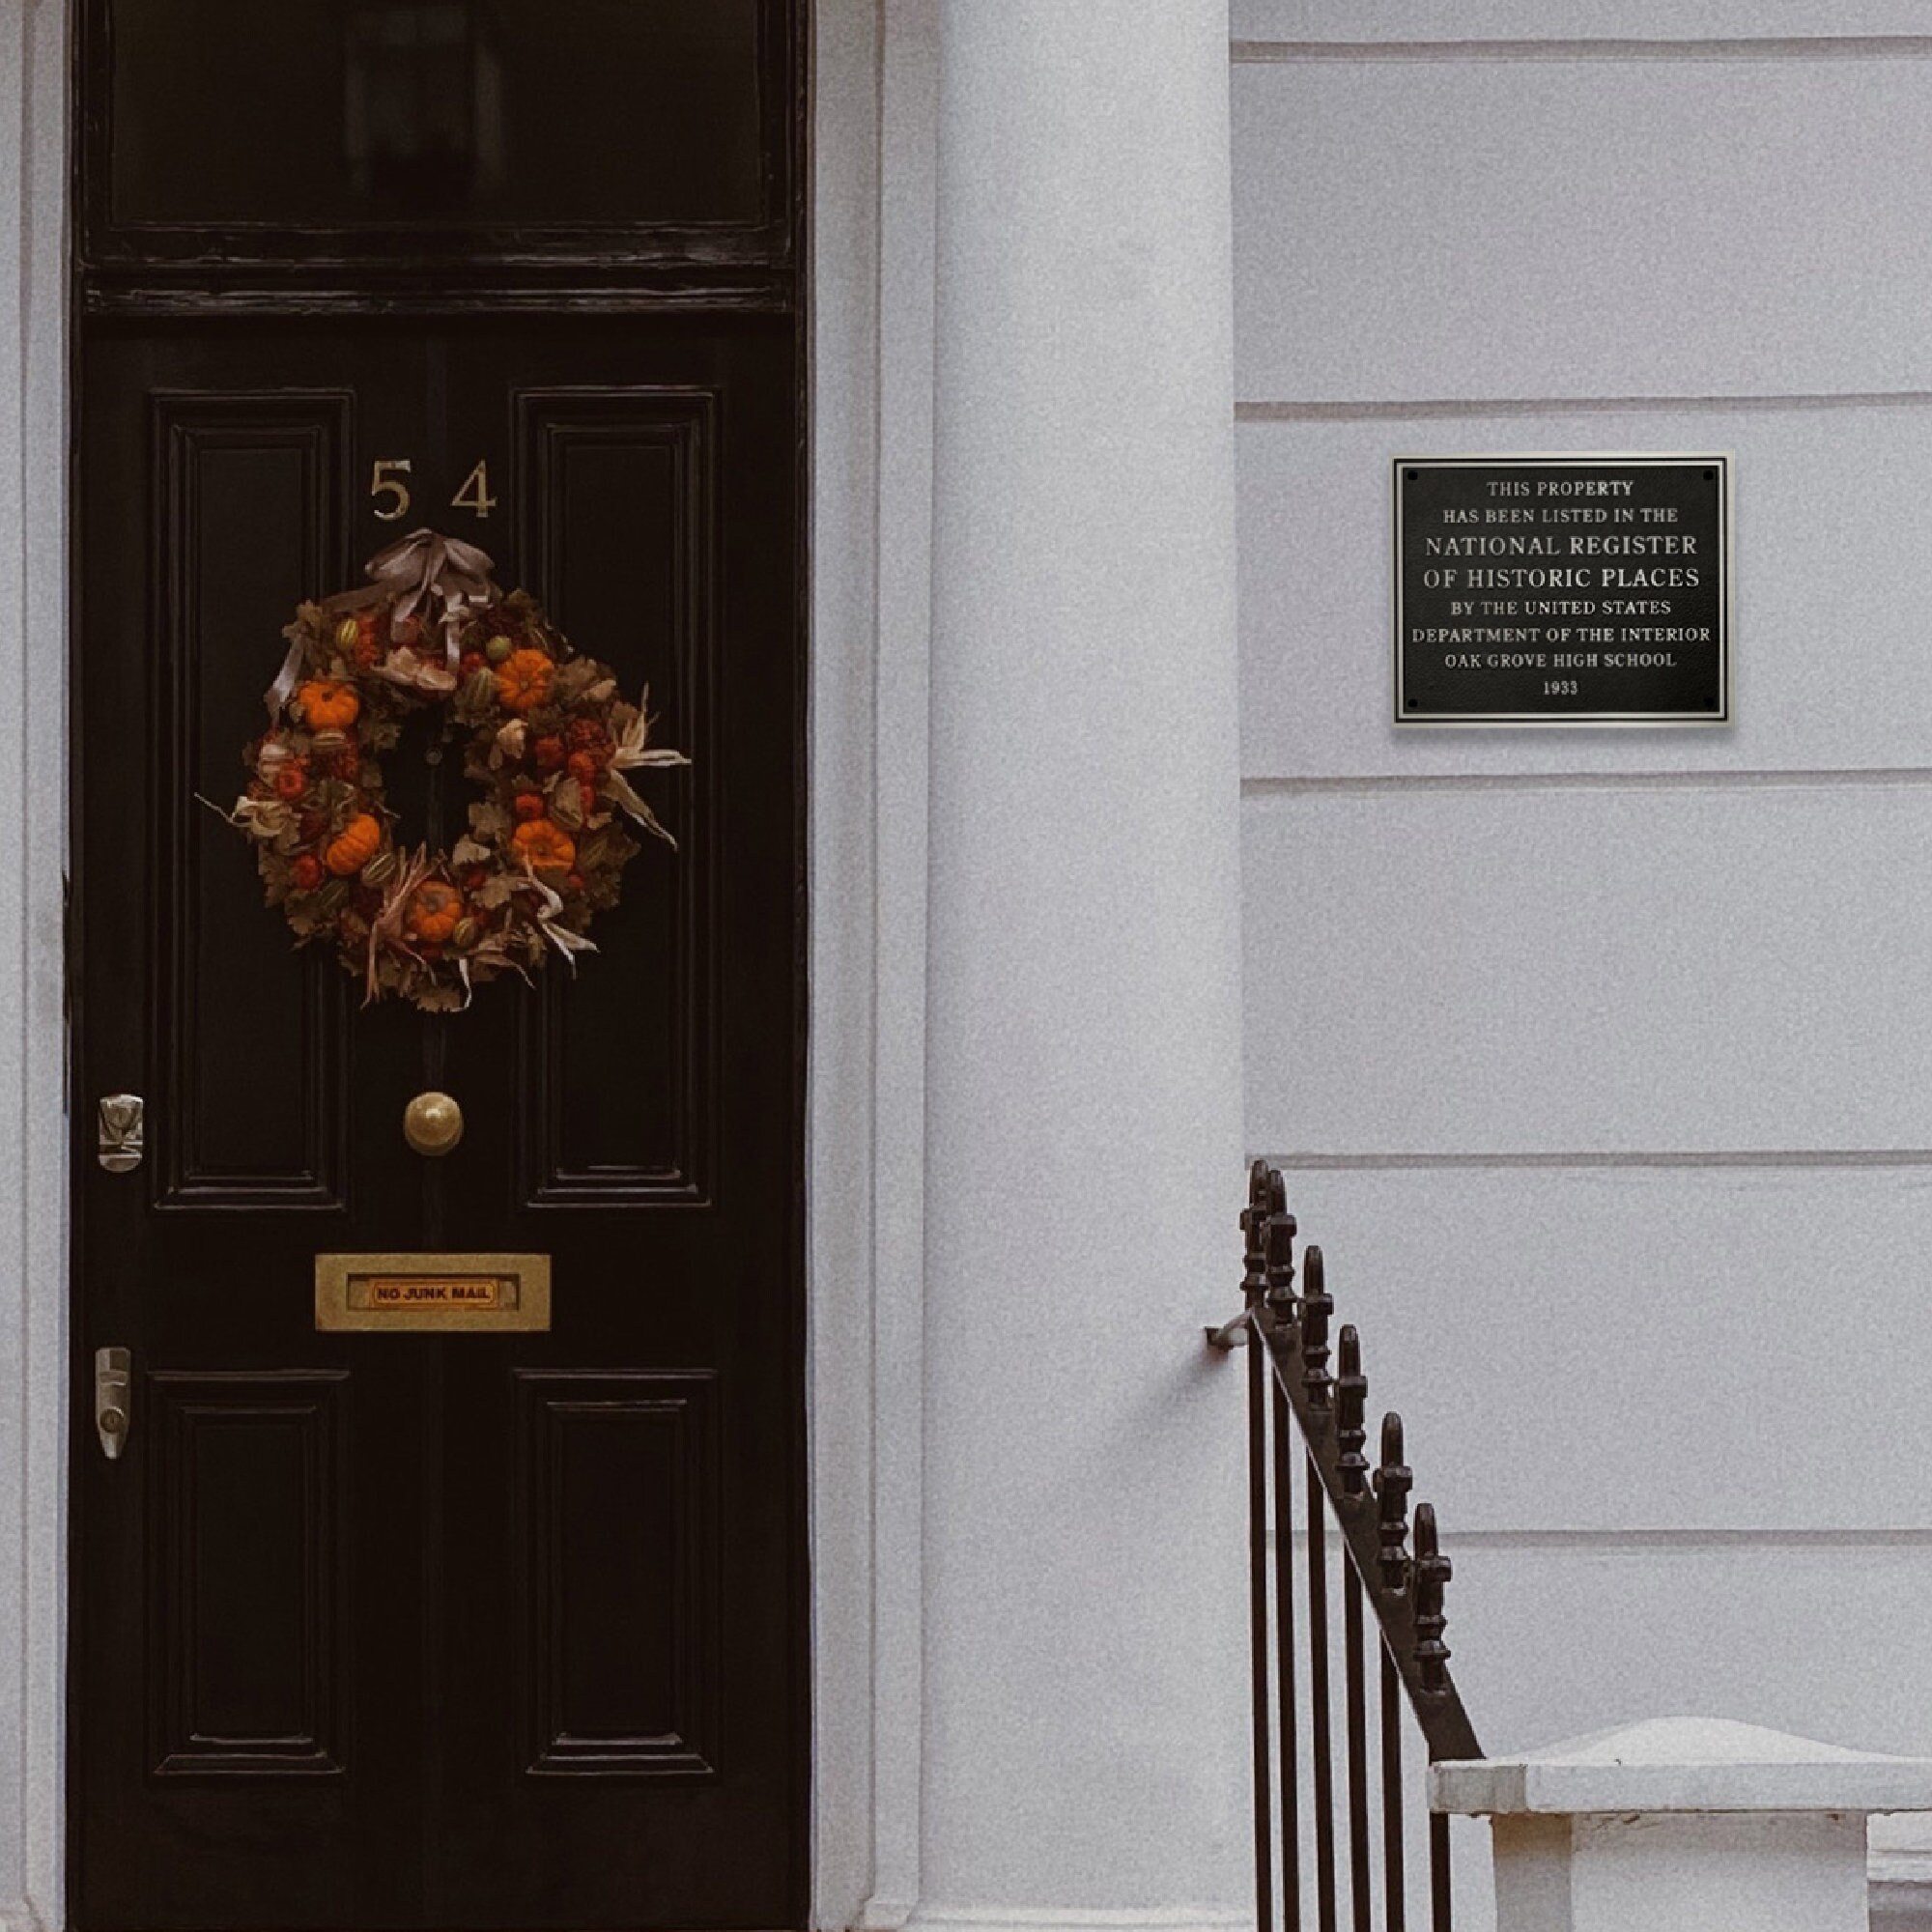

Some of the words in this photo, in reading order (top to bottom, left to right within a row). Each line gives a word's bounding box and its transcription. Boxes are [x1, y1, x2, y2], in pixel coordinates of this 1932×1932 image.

[1487, 480, 1530, 497] THIS
[1537, 480, 1634, 497] PROPERTY
[1443, 508, 1480, 524] HAS
[1486, 508, 1535, 524] BEEN
[1542, 508, 1607, 524] LISTED
[1614, 508, 1634, 524] IN
[1640, 508, 1678, 523] THE
[1426, 536, 1561, 556] NATIONAL
[1570, 536, 1698, 555] REGISTER
[1424, 569, 1459, 588] OF
[1467, 569, 1591, 588] HISTORIC
[1601, 568, 1700, 587] PLACES
[1451, 602, 1474, 615] BY
[1481, 602, 1518, 615] THE
[1524, 602, 1596, 615] UNITED
[1602, 602, 1671, 614] STATES
[1412, 628, 1541, 643] DEPARTMENT
[1546, 628, 1572, 642] OF
[1577, 628, 1615, 642] THE
[1622, 628, 1711, 642] INTERIOR
[1444, 653, 1482, 668] OAK
[1487, 653, 1547, 668] GROVE
[1553, 653, 1598, 668] HIGH
[1605, 653, 1677, 668] SCHOOL
[1544, 680, 1578, 696] 1933
[378, 1288, 401, 1299] NO
[404, 1288, 447, 1299] JUNK
[451, 1287, 491, 1299] MAIL
